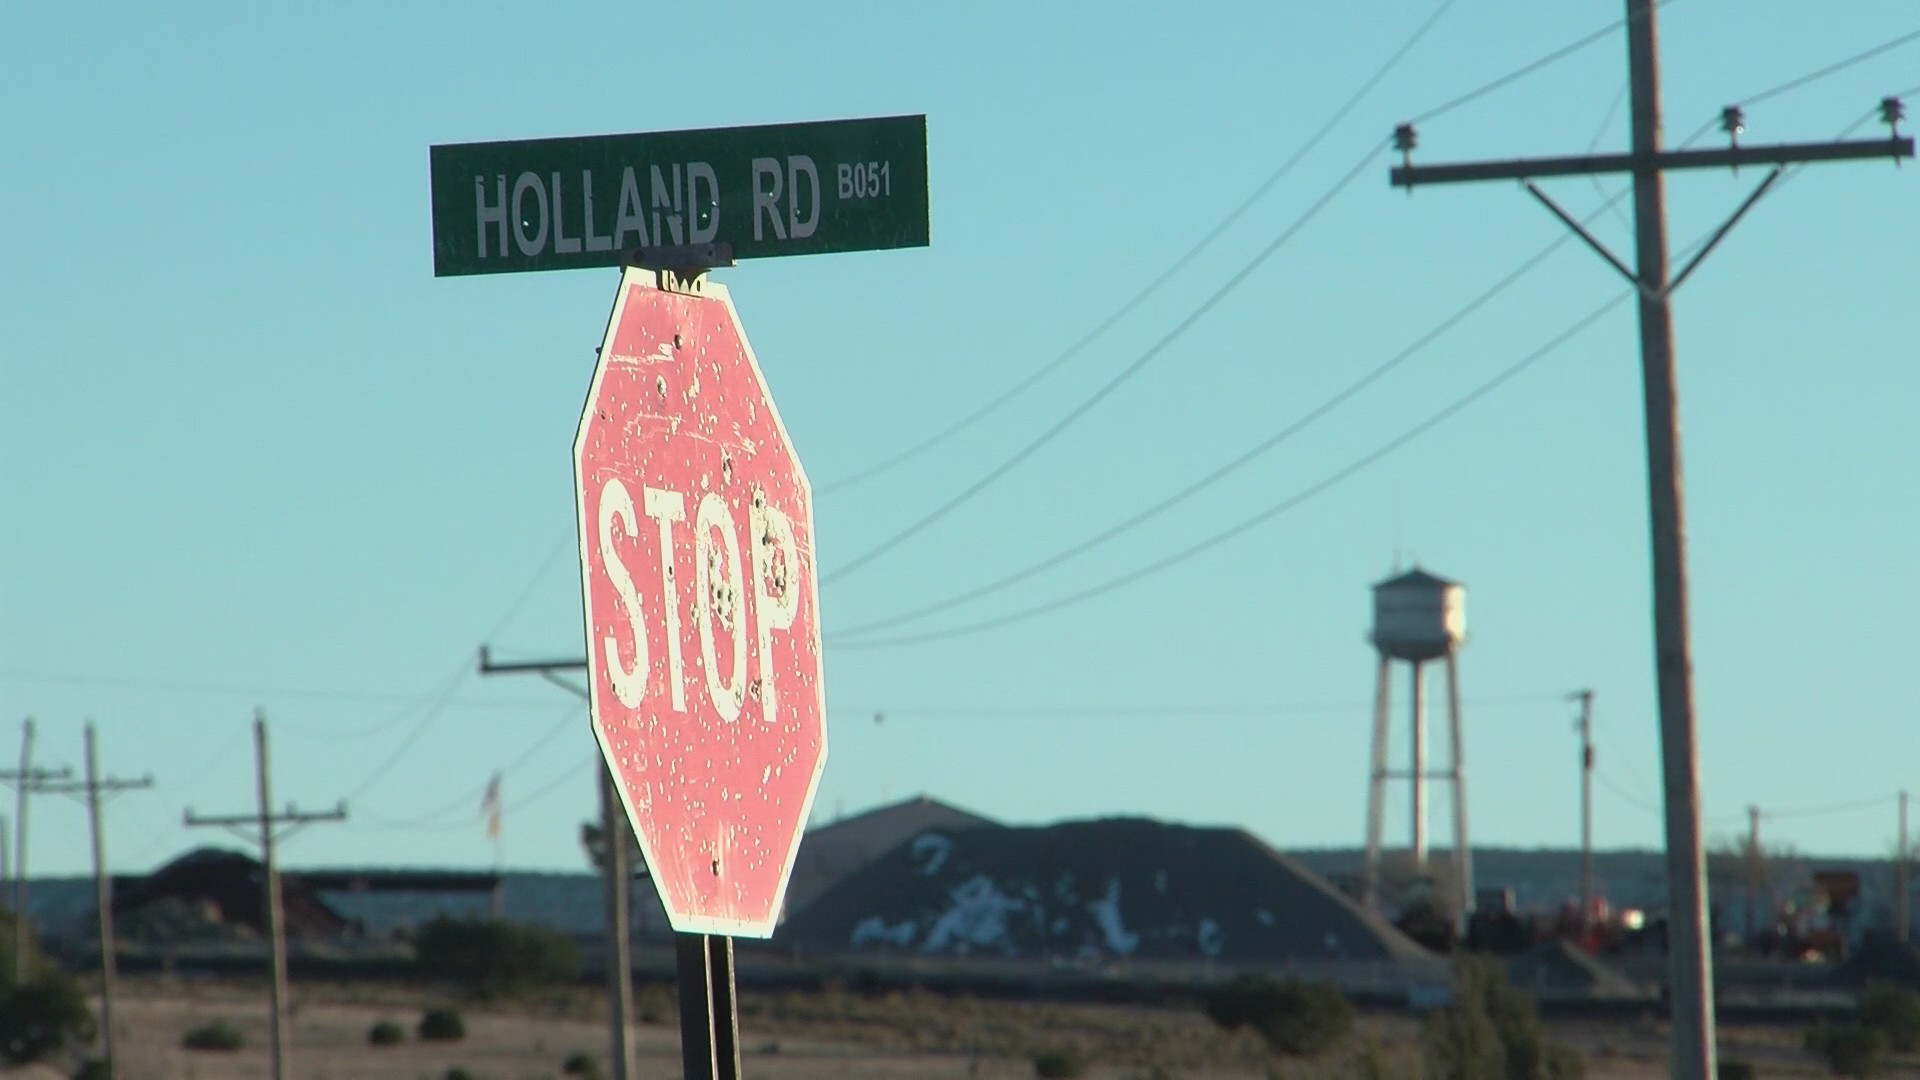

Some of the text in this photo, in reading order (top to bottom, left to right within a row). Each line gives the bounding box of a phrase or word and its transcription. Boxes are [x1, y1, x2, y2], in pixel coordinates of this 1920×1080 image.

[474, 155, 891, 258] HOLLAND RD B051
[598, 478, 799, 723] STOP
